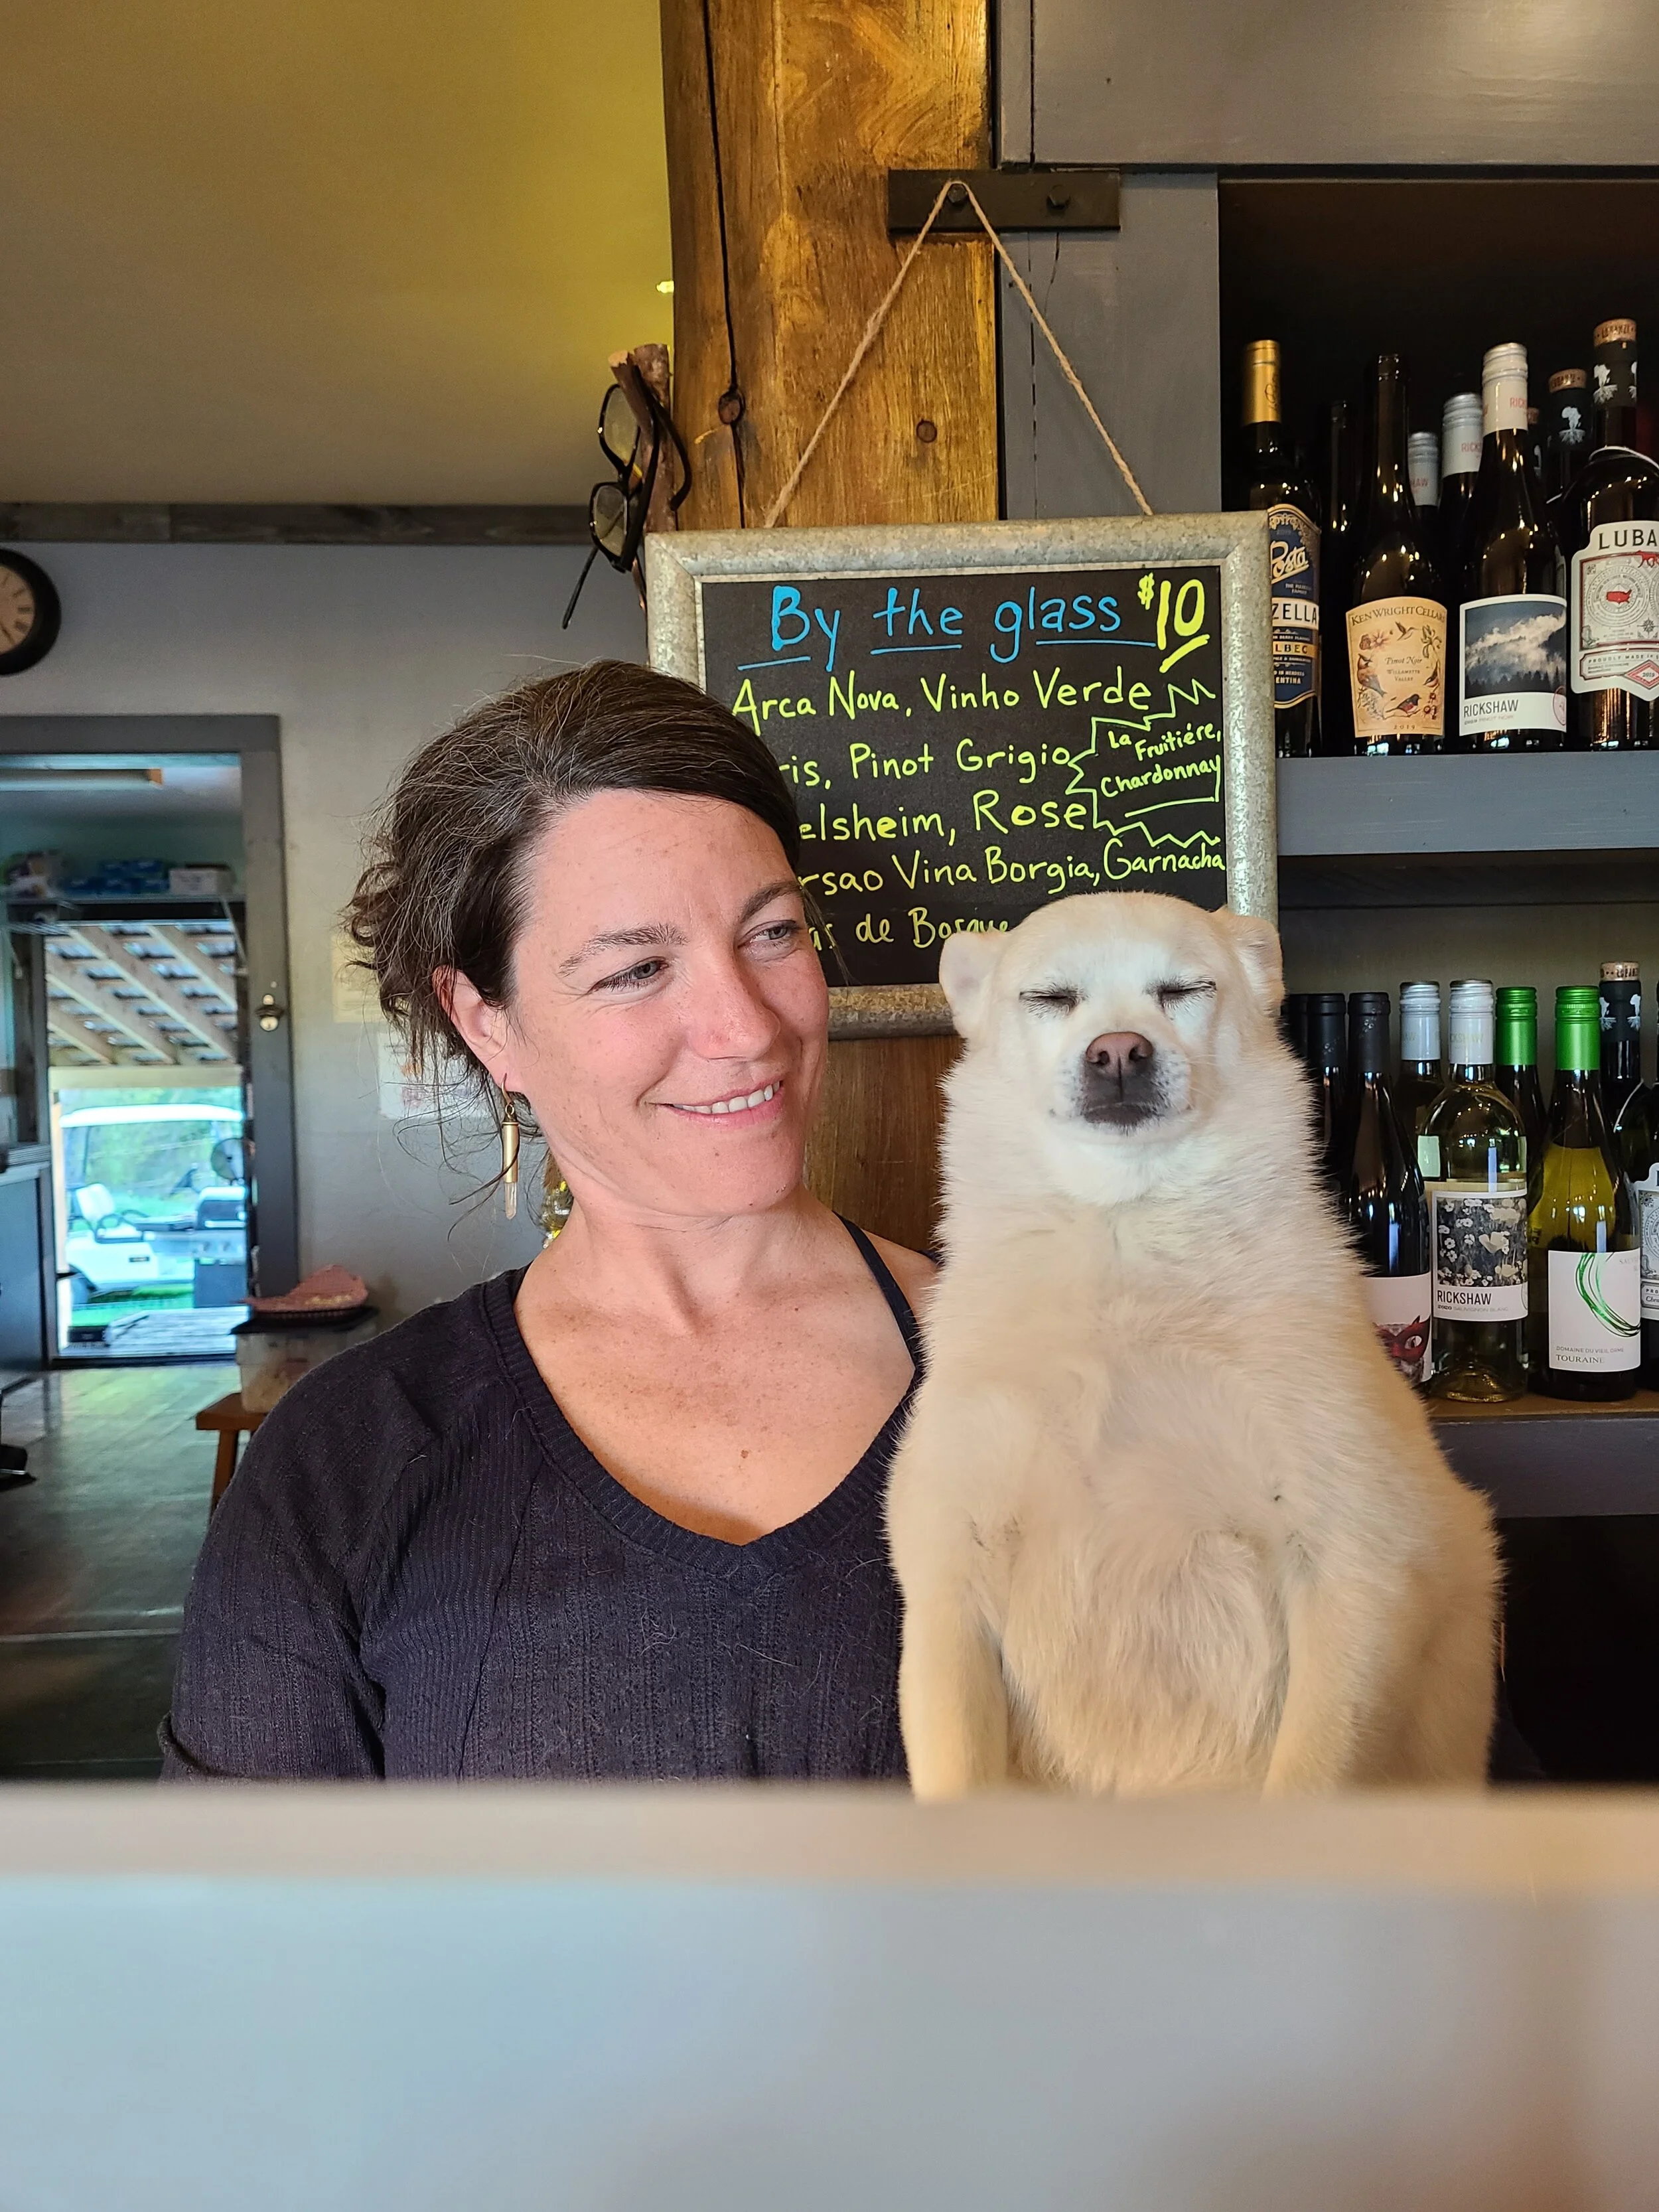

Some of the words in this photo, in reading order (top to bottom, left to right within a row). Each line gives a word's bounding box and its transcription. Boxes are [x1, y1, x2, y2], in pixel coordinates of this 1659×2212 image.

[1599, 529, 1657, 550] LUBA
[1269, 540, 1309, 578] Posta
[771, 585, 841, 672] By
[873, 587, 963, 636] the
[990, 586, 1121, 664] glass
[1137, 572, 1204, 650] $10
[1352, 613, 1372, 626] KEN
[1372, 605, 1415, 618] WRIGHT
[731, 678, 817, 737] Arca
[829, 670, 912, 717] Nova,
[920, 672, 1020, 712] Vinho
[1033, 666, 1152, 711] Verde
[1463, 699, 1518, 718] RICKSHAW
[849, 743, 934, 779] Pinot
[956, 738, 1070, 784] Grigio
[1100, 755, 1220, 799] Chardonnay
[973, 789, 1088, 834] Rose
[891, 849, 977, 889] Vina
[985, 846, 1100, 894] Borgia,
[1102, 838, 1226, 880] Garnacha
[855, 913, 895, 944] de
[1437, 1290, 1492, 1305] RICKSHAW
[1556, 1355, 1605, 1364] TOURAINE
